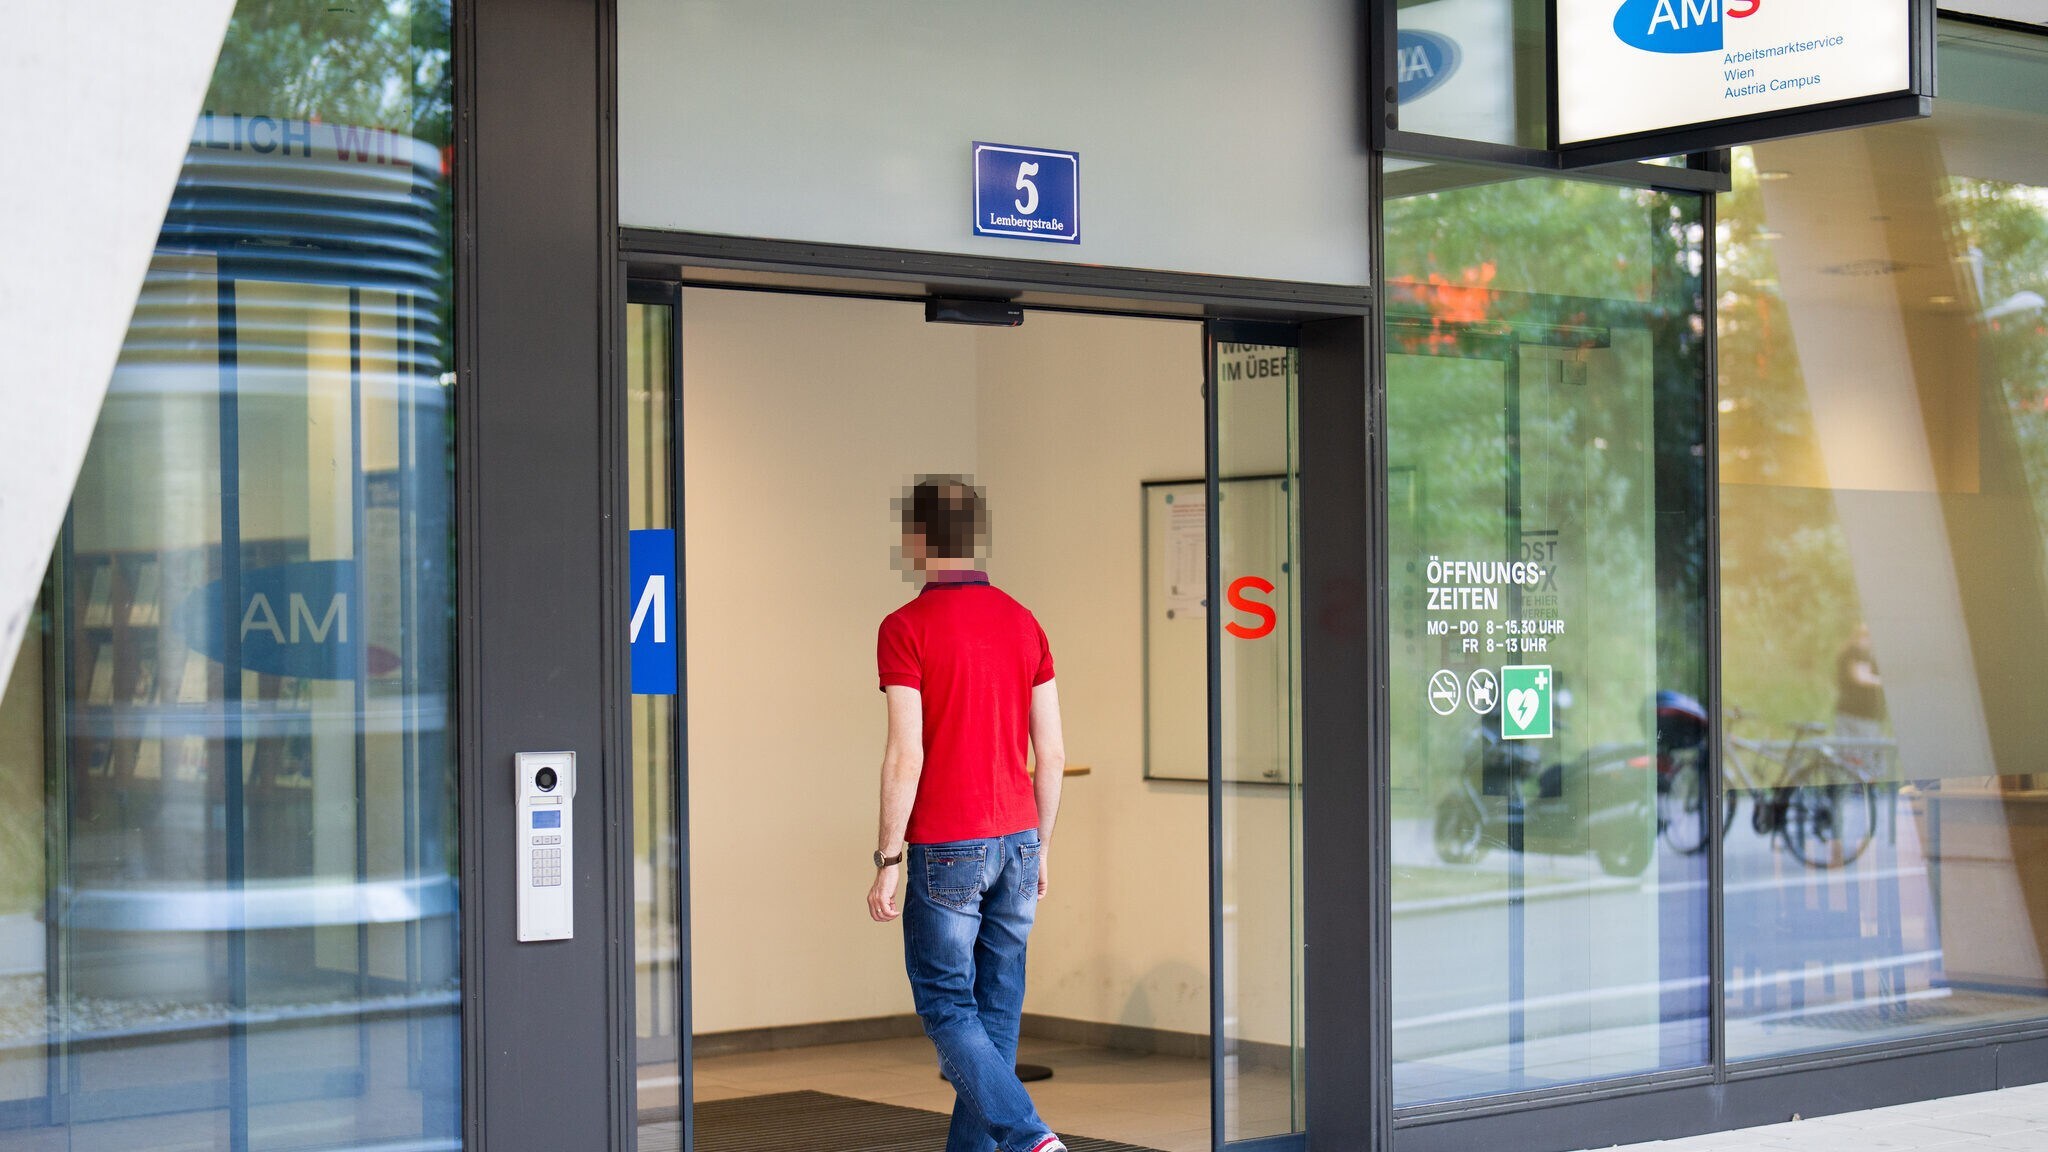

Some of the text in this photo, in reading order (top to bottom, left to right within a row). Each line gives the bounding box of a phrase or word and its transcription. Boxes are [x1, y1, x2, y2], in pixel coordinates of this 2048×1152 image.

[1724, 33, 1844, 64] Arbeitsmarktservice
[1724, 66, 1755, 82] Wien
[1724, 72, 1821, 99] Austria Campus
[190, 110, 311, 158] LICH
[1015, 161, 1039, 215] 5
[990, 212, 1064, 231] Lembergstraße
[1222, 361, 1242, 382] IM
[1426, 555, 1546, 585] ÖFFNUNGS-
[1225, 576, 1276, 640] S
[1426, 587, 1498, 610] ZEITEN
[240, 592, 348, 644] AM
[1539, 620, 1565, 634] UHR
[1462, 639, 1479, 653] FR
[1520, 638, 1547, 652] UHR
